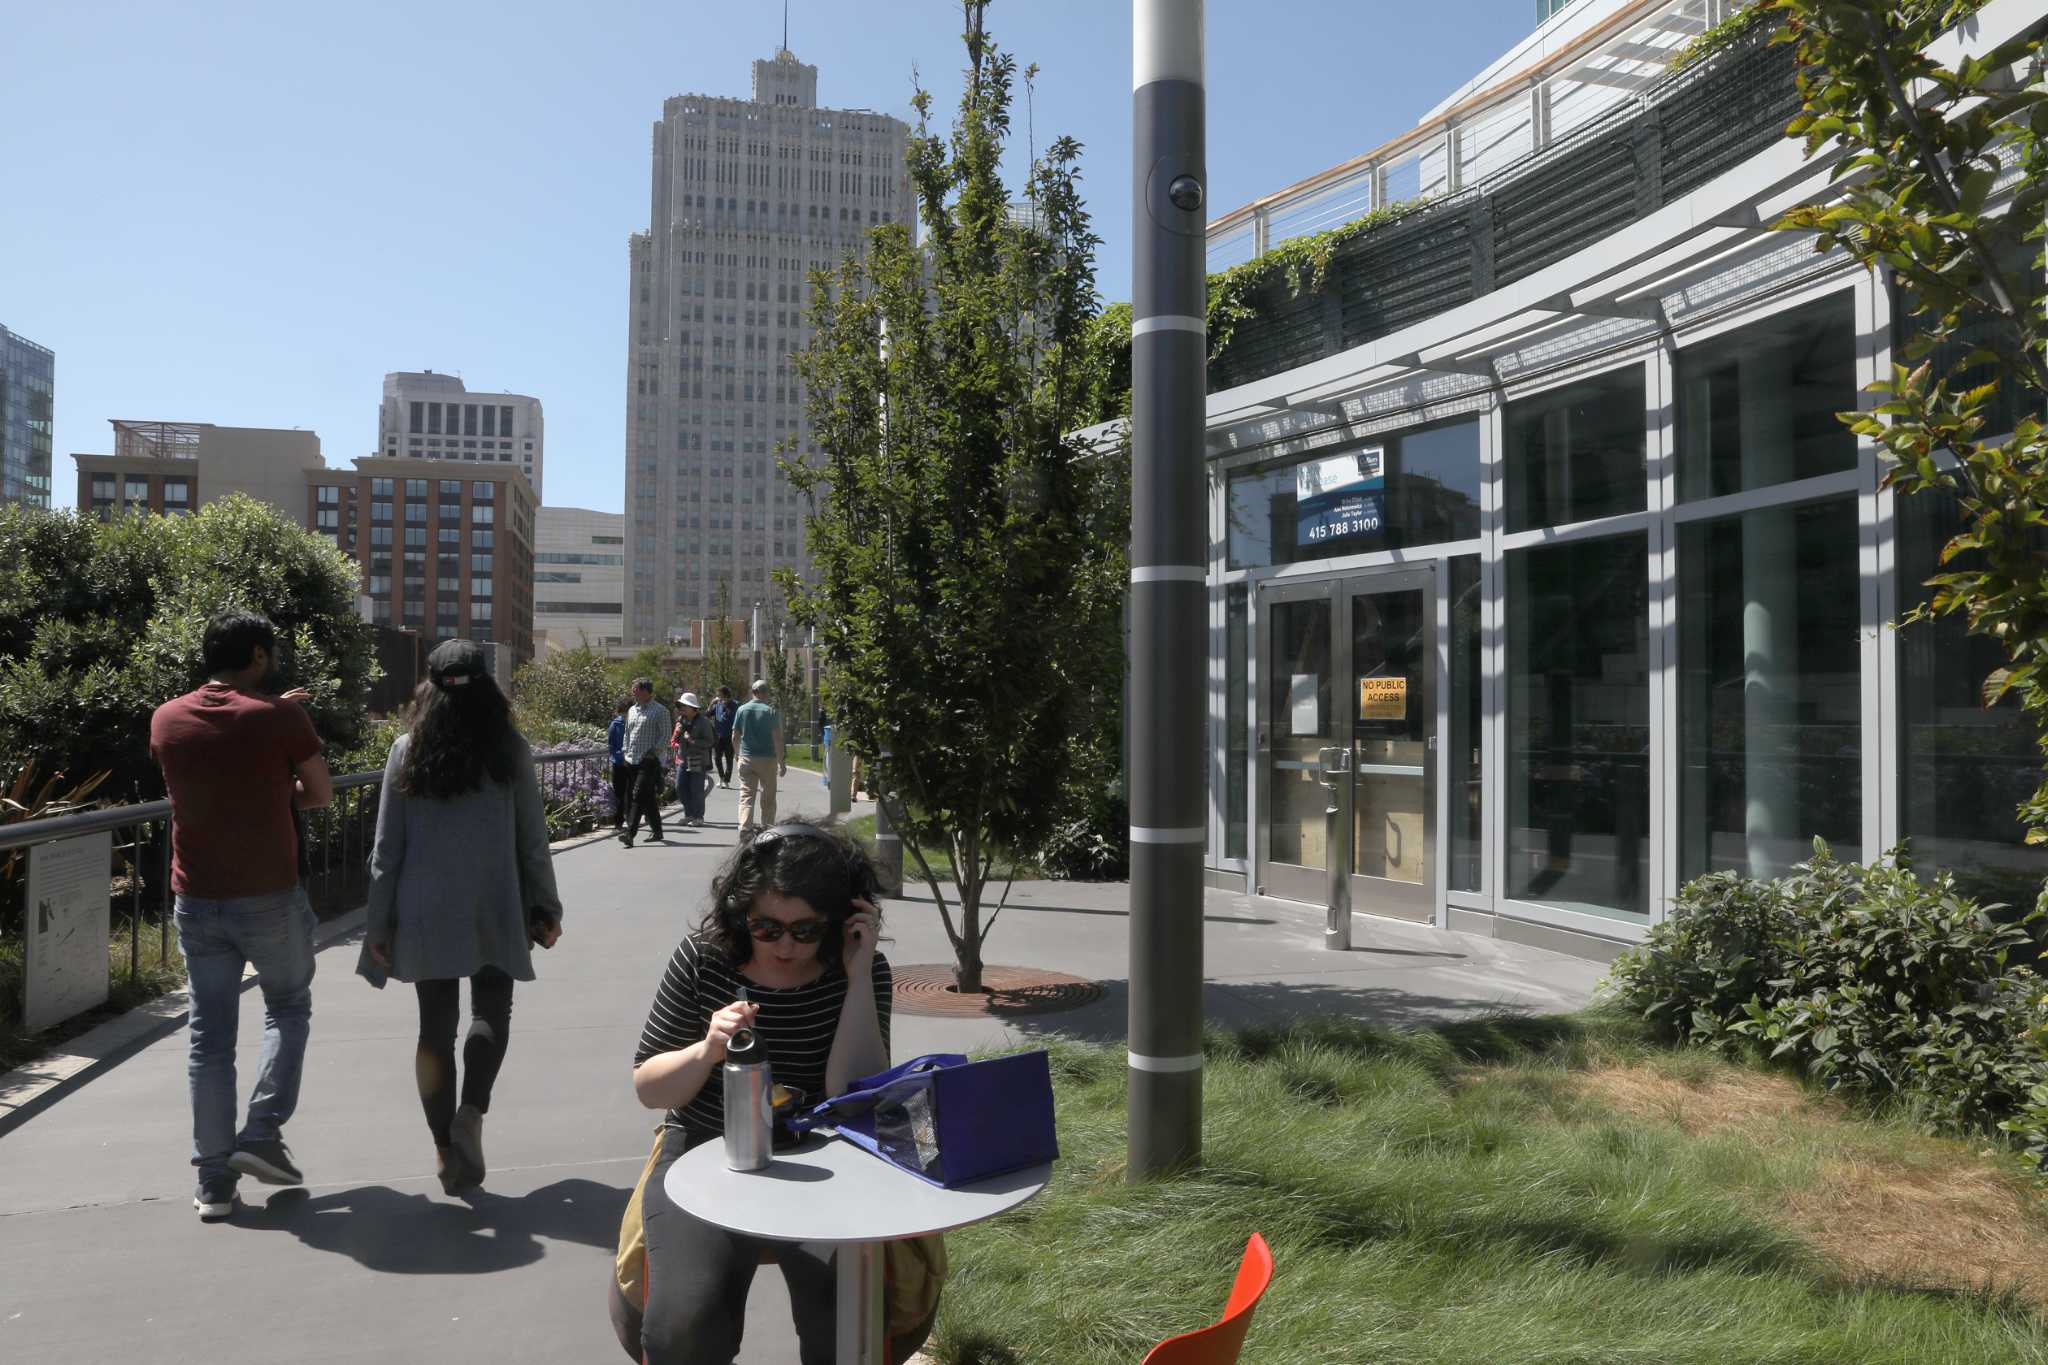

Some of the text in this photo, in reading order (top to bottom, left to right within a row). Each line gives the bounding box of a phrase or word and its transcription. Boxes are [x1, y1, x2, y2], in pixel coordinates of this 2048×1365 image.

[1309, 517, 1378, 539] 415 788 3100
[1363, 681, 1404, 689] NO PUBLIC
[1368, 693, 1400, 702] ACCESS
